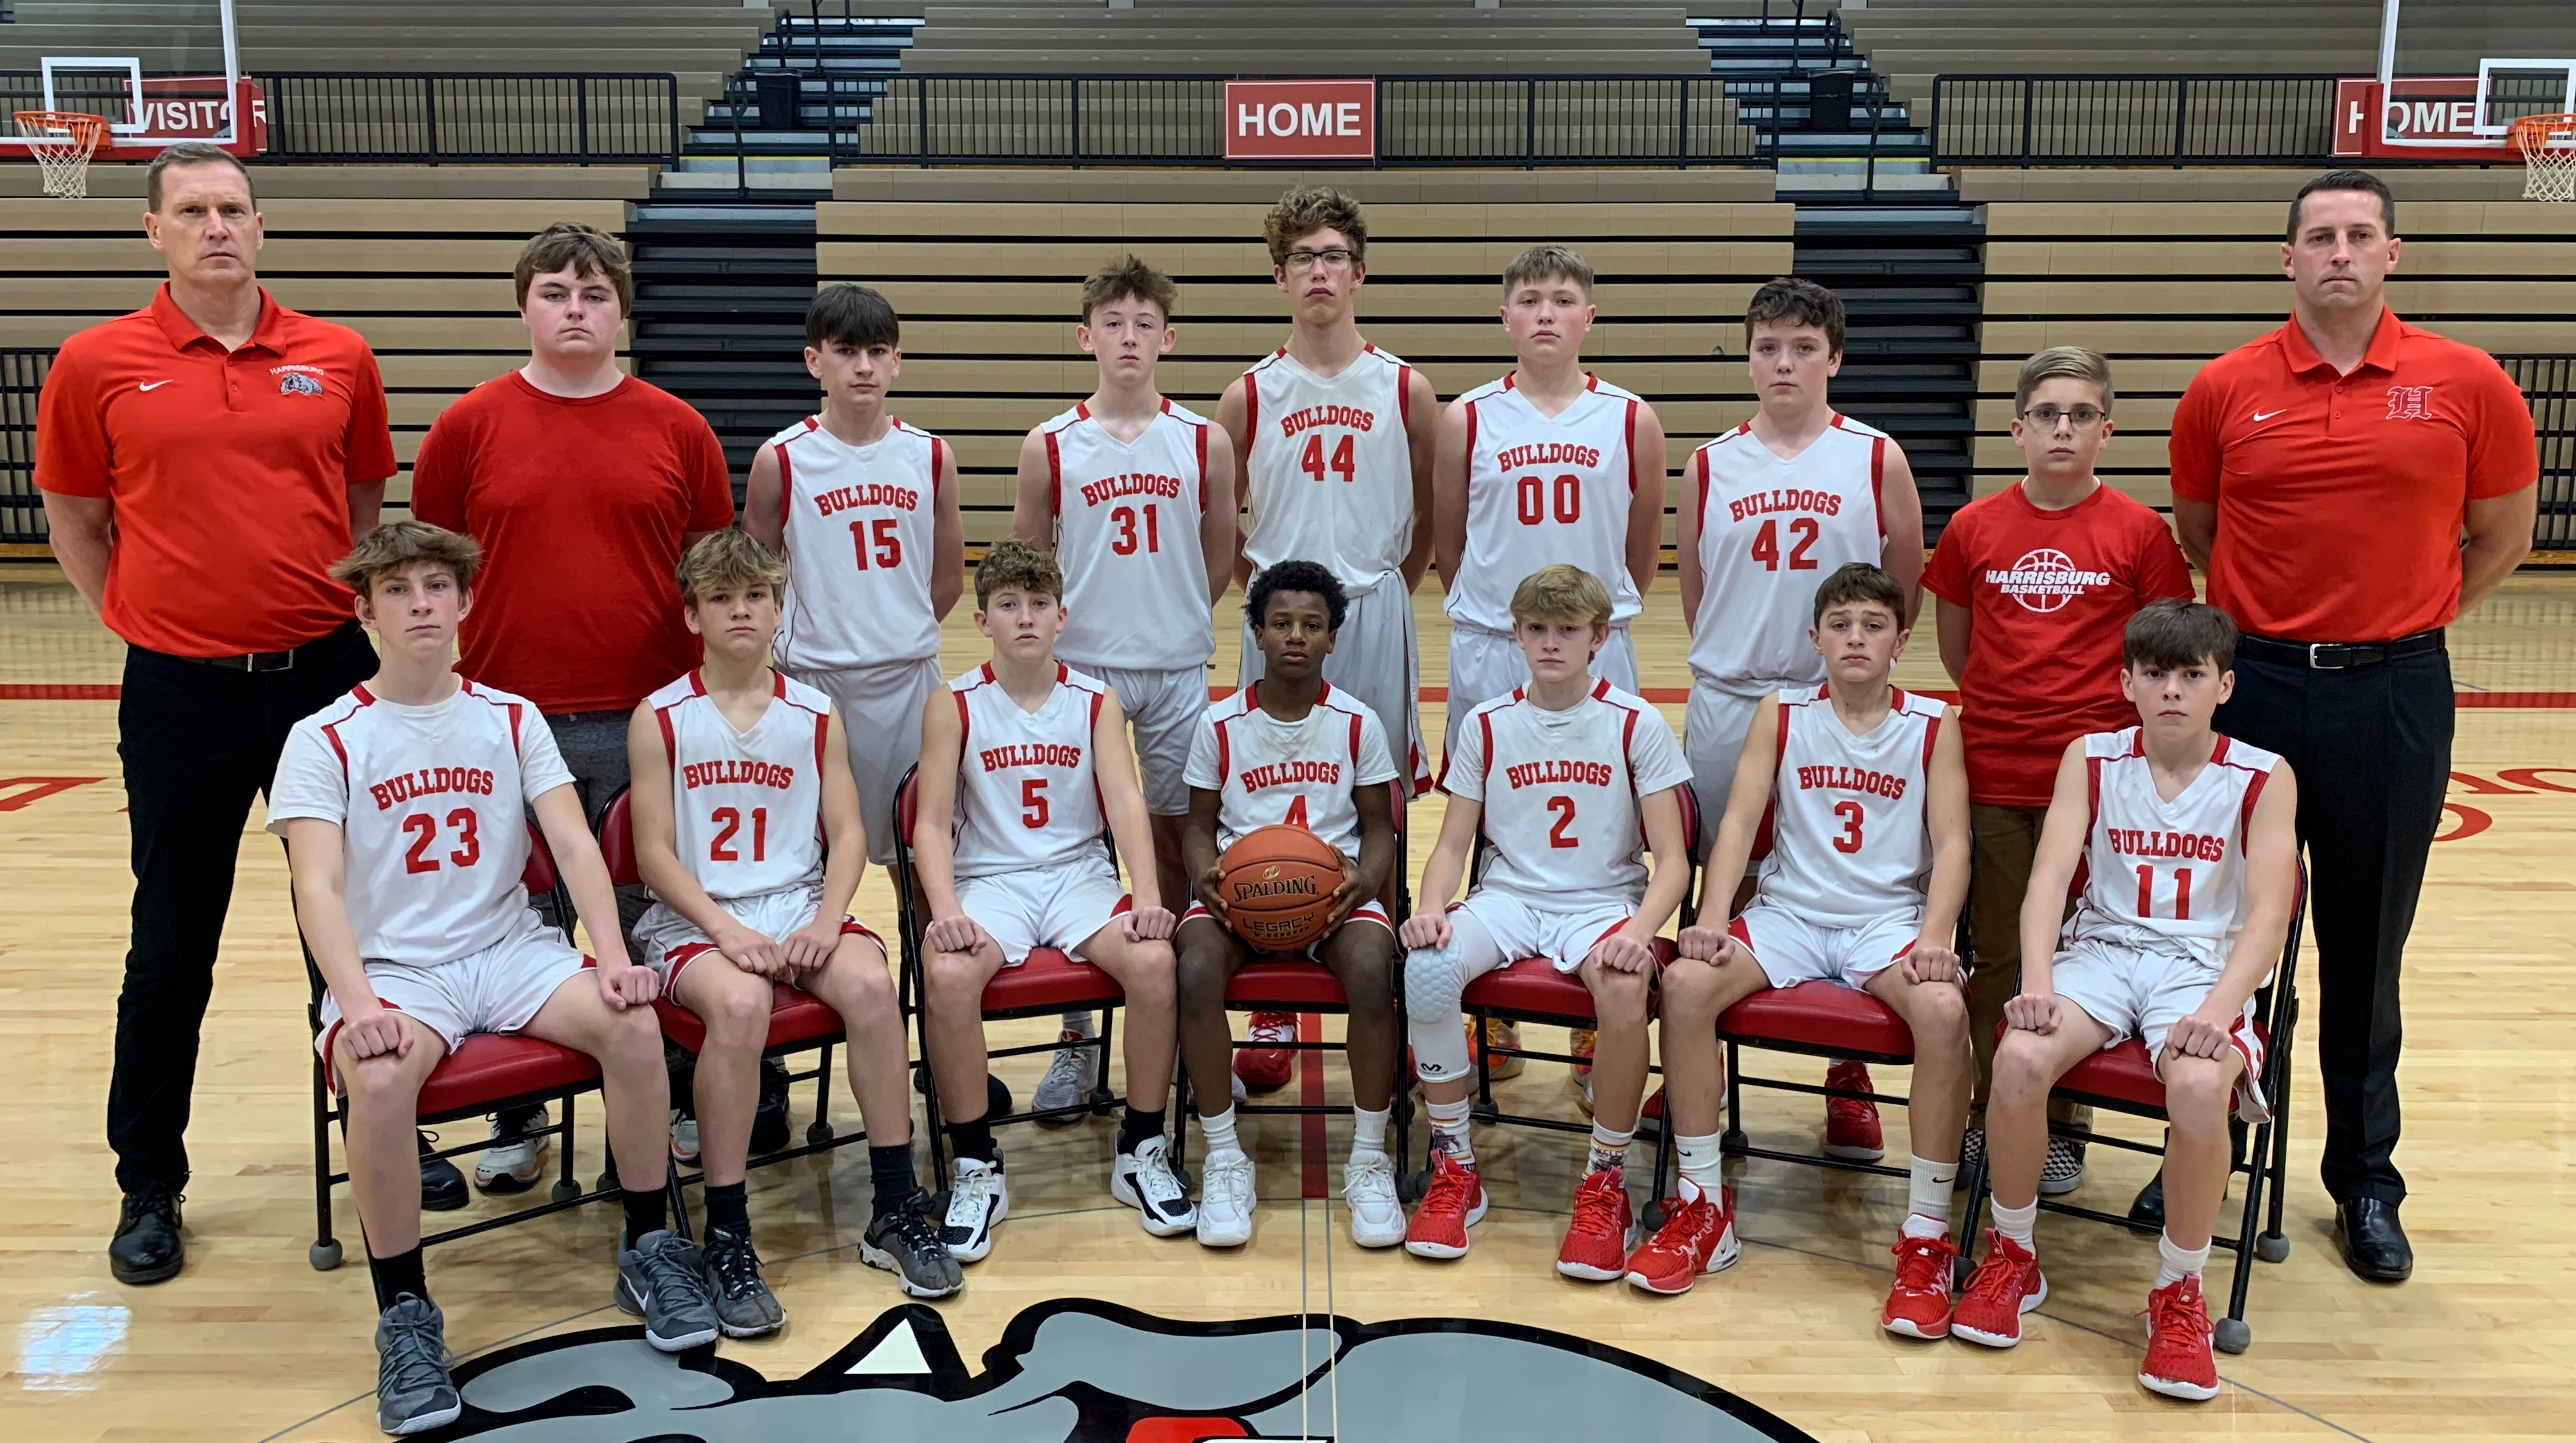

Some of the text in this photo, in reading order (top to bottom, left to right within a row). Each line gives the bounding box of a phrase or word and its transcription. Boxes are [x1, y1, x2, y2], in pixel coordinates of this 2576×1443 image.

[130, 100, 266, 131] VISITR
[1239, 103, 1361, 137] HOME
[269, 365, 324, 375] HARRISBURG
[1281, 405, 1374, 438] BULLDOGS
[1301, 434, 1355, 482] 44
[1497, 443, 1599, 473] BULLDOGS
[814, 484, 918, 517] BULLDOGS
[1081, 473, 1180, 507] BULLDOGS
[1517, 474, 1580, 525] 00
[1729, 489, 1842, 523] BULLDOGS
[849, 519, 901, 571] 15
[1111, 503, 1158, 555] 31
[1751, 517, 1818, 571] 42
[1985, 570, 2110, 585] HARRISBURG
[2000, 585, 2084, 594] BASKETBALL
[684, 760, 794, 790] BULLDOGS
[980, 744, 1081, 772] BULLDOGS
[370, 767, 494, 811] BULLDOGS
[1241, 761, 1340, 794] BULLDOGS
[1506, 761, 1612, 790] BULLDOGS
[1797, 766, 1906, 800] BULLDOGS
[1022, 778, 1049, 829] 5
[1283, 795, 1309, 830] 4
[710, 807, 766, 862] 21
[1547, 796, 1579, 848] 2
[1833, 800, 1864, 854] 3
[403, 807, 480, 874] 23
[2108, 828, 2224, 862] BULLDOGS
[1234, 874, 1316, 903] SPALDING
[2136, 864, 2192, 920] 11
[1243, 912, 1315, 932] LEGACY
